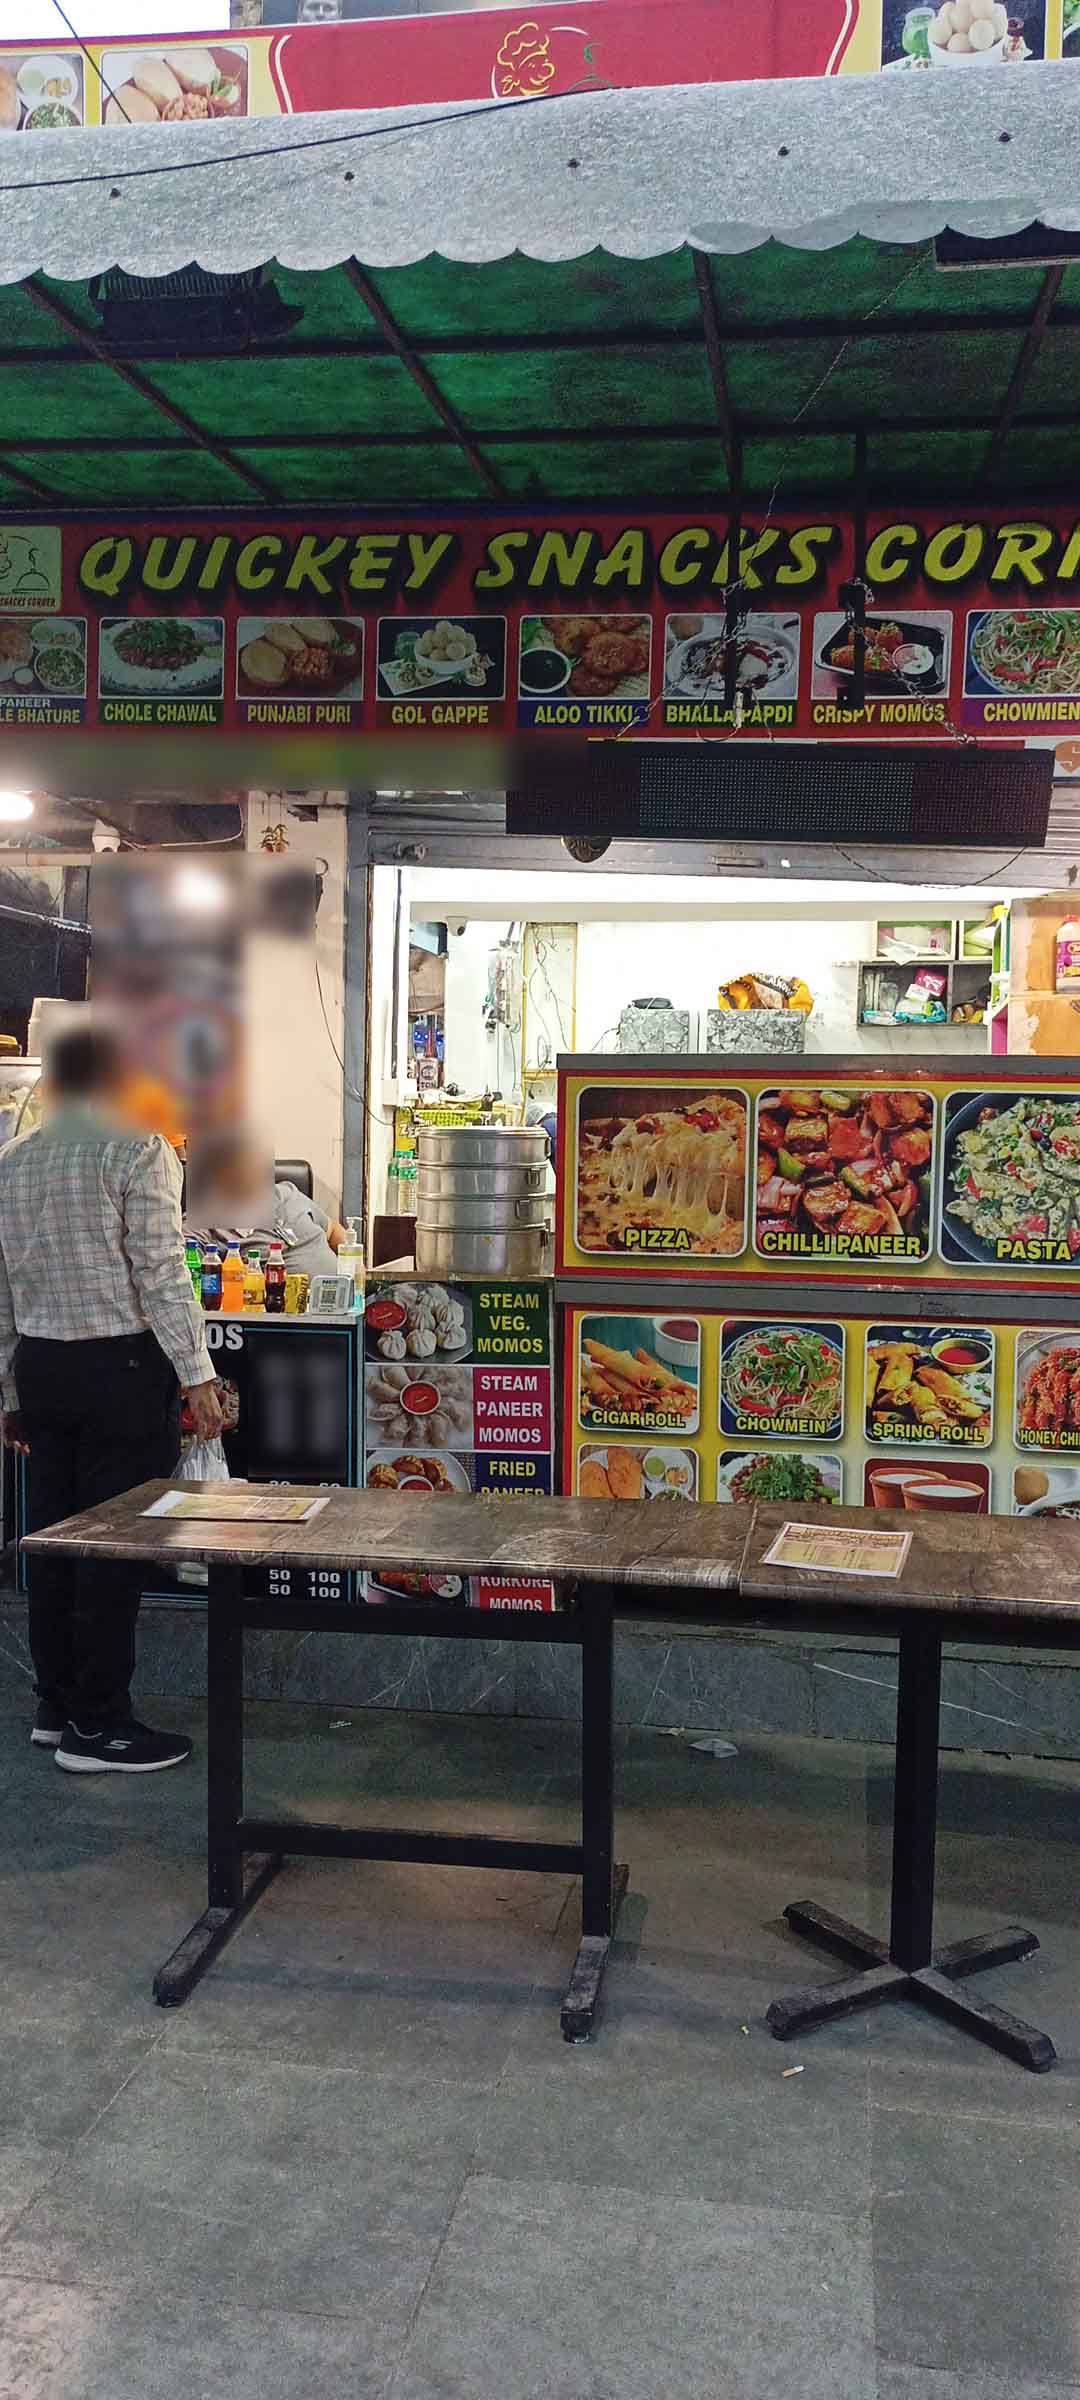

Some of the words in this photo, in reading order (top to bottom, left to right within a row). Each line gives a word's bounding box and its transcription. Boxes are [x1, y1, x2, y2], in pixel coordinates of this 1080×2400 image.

[80, 534, 453, 595] QUICKEY
[475, 527, 834, 589] SNACKS
[0, 698, 51, 708] PANEER
[18, 709, 80, 723] BHATURE
[104, 703, 153, 721] CHOLE
[157, 704, 217, 722] CHAWAL
[247, 704, 311, 723] PUNJABI
[316, 704, 351, 723] PURI
[391, 705, 427, 724] GOL
[432, 705, 489, 724] GAPPE
[534, 705, 584, 724] ALOO
[587, 705, 633, 723] TIKKI
[880, 703, 945, 722] MOMOS
[625, 1228, 690, 1250] PIZZA
[762, 1233, 833, 1255] CHILLI
[838, 1235, 921, 1256] PANEER
[996, 1239, 1072, 1261] PASTA
[479, 1293, 540, 1309] STEAM
[490, 1316, 531, 1331] VEG.
[477, 1338, 543, 1353] MOMOS
[480, 1376, 538, 1391] STEAM
[476, 1402, 543, 1417] PANEER
[591, 1409, 641, 1427] CIGAR
[644, 1411, 685, 1429] ROLL
[735, 1415, 826, 1435] CHOWMEIN
[479, 1428, 541, 1443] MOMOS
[872, 1422, 934, 1441] SPRING
[939, 1424, 984, 1442] ROLL
[1020, 1430, 1057, 1445] HONEY
[489, 1461, 536, 1476] FRIED
[269, 1569, 291, 1581] 50
[308, 1571, 340, 1583] 100
[269, 1584, 291, 1596] 50
[308, 1586, 340, 1598] 100
[489, 1598, 543, 1611] MOMOS
